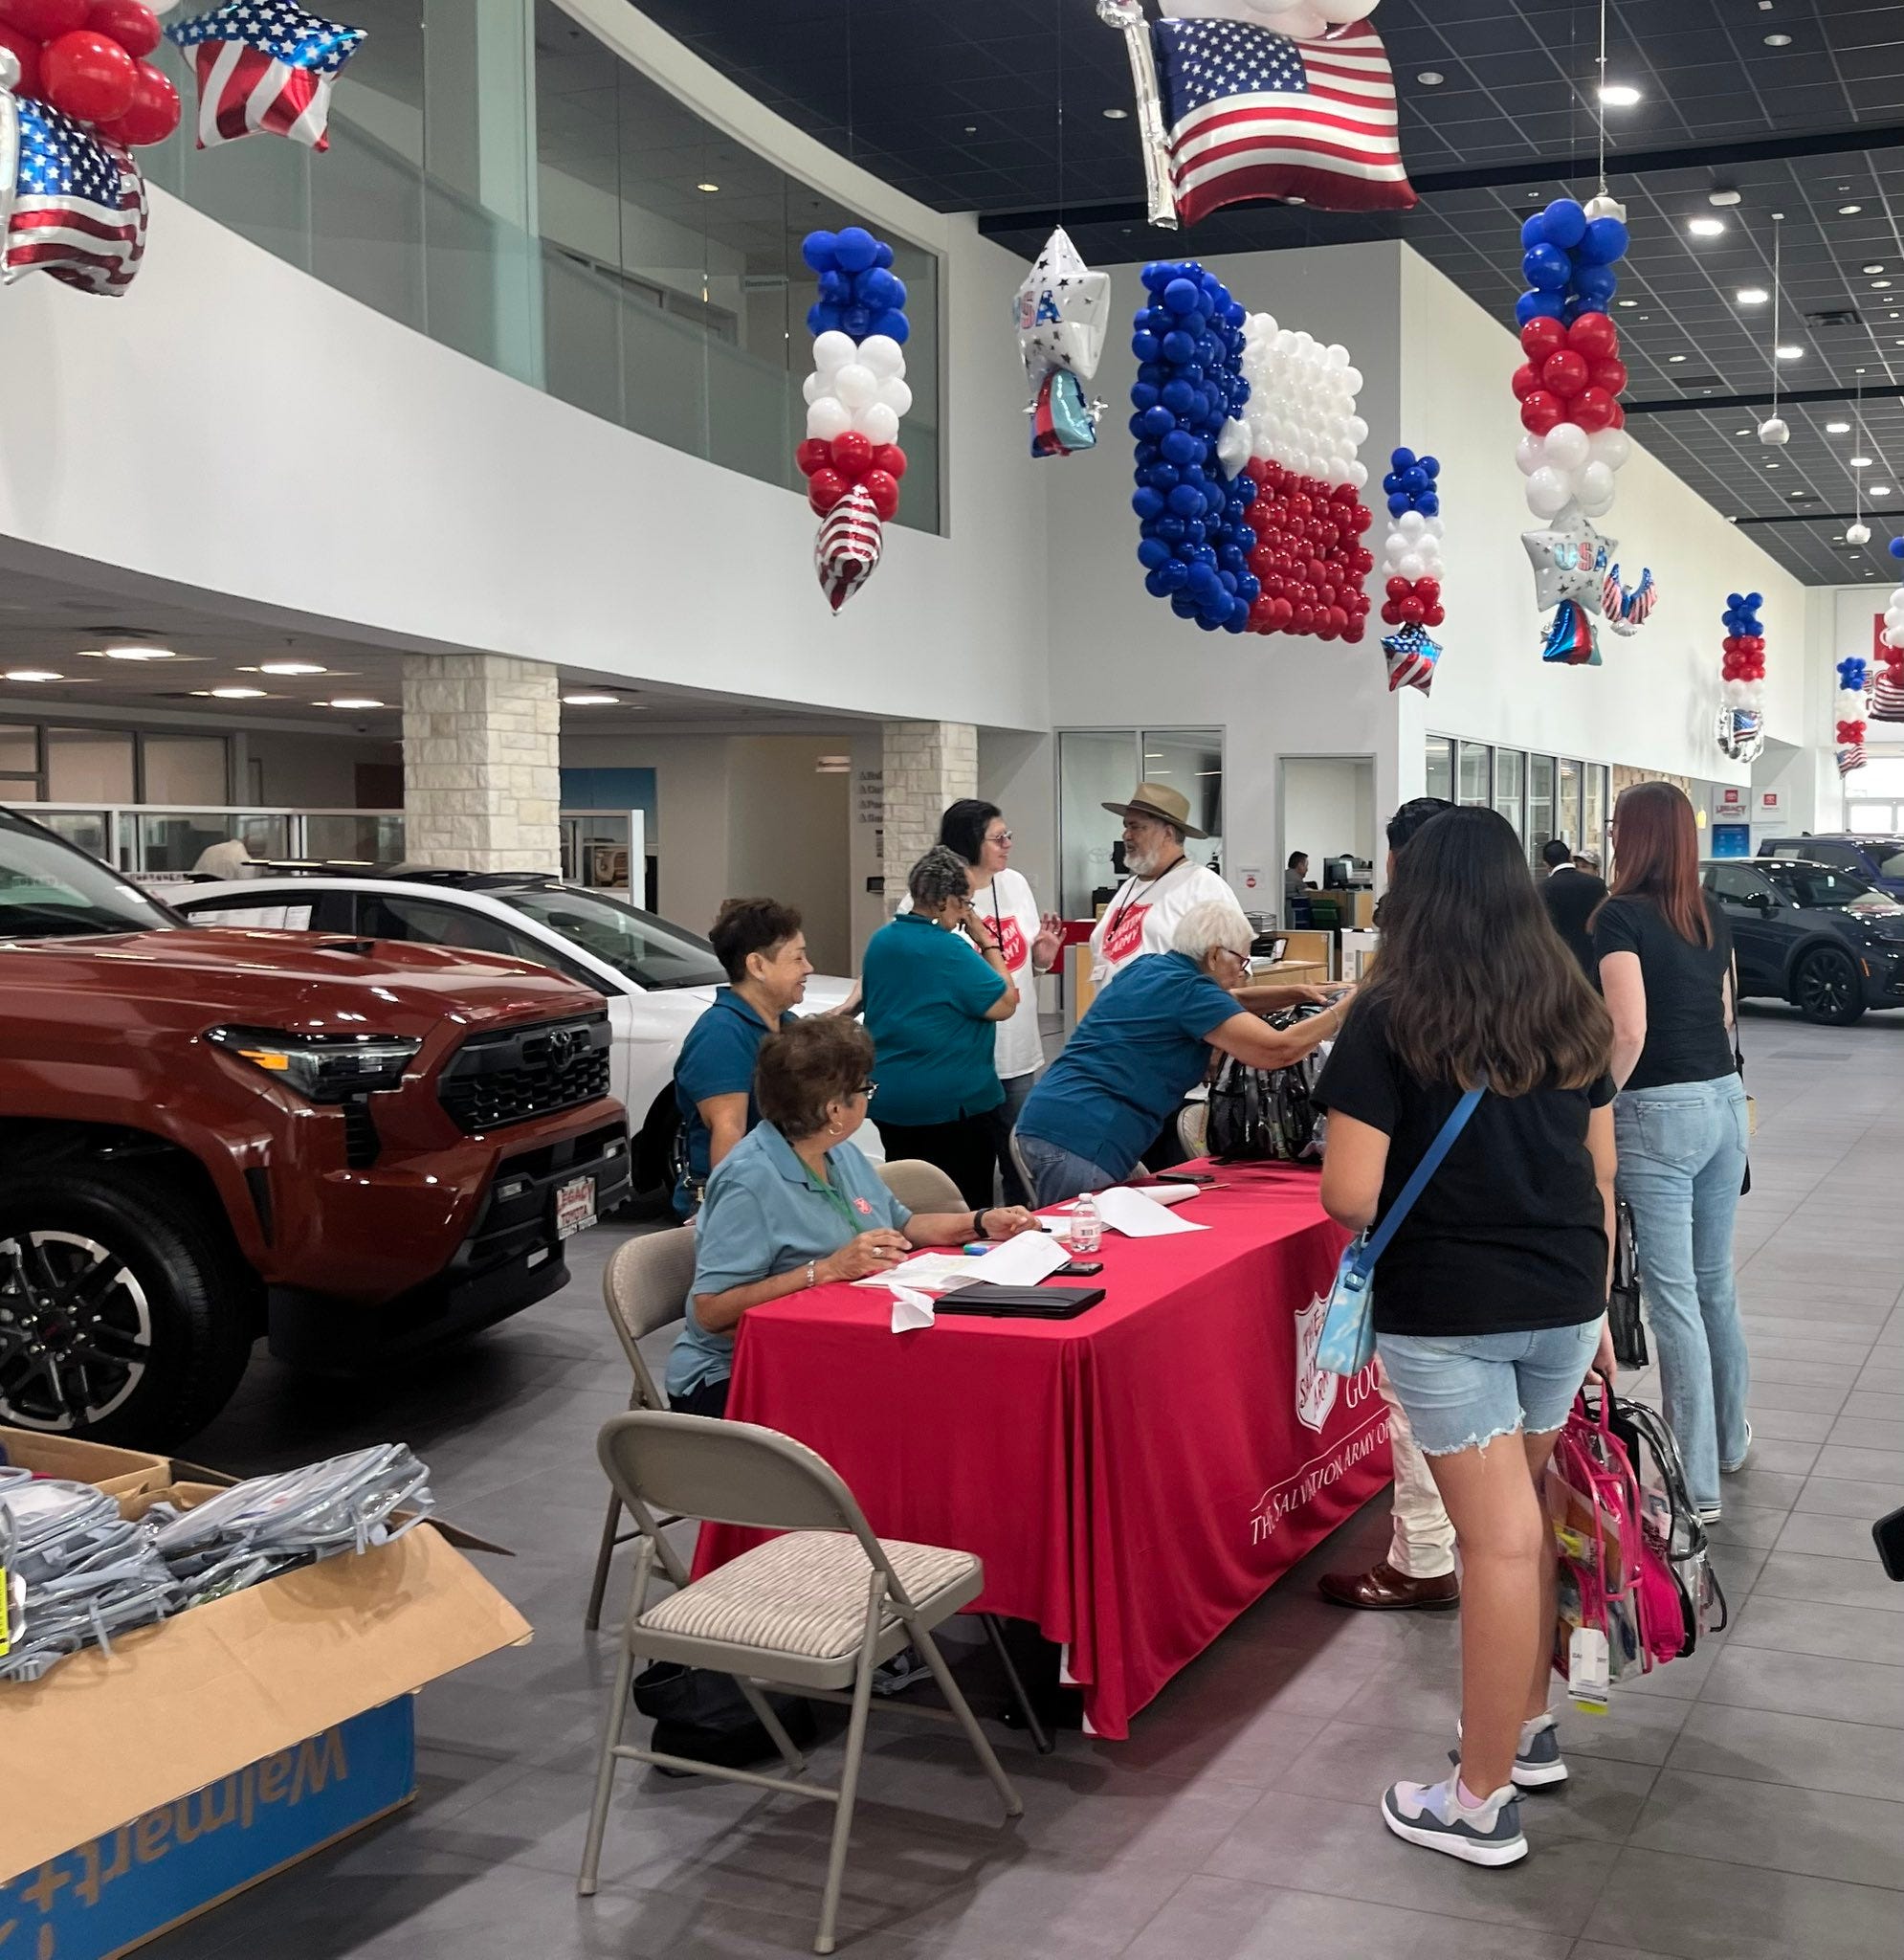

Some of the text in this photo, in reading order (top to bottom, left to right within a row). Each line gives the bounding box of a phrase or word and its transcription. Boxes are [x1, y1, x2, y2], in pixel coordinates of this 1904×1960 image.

[1554, 542, 1607, 572] USA
[557, 1182, 593, 1213] LEGACY
[561, 1204, 588, 1226] TOYOTA
[1273, 1455, 1343, 1522] SALVATION
[1343, 1429, 1375, 1472] ARMY
